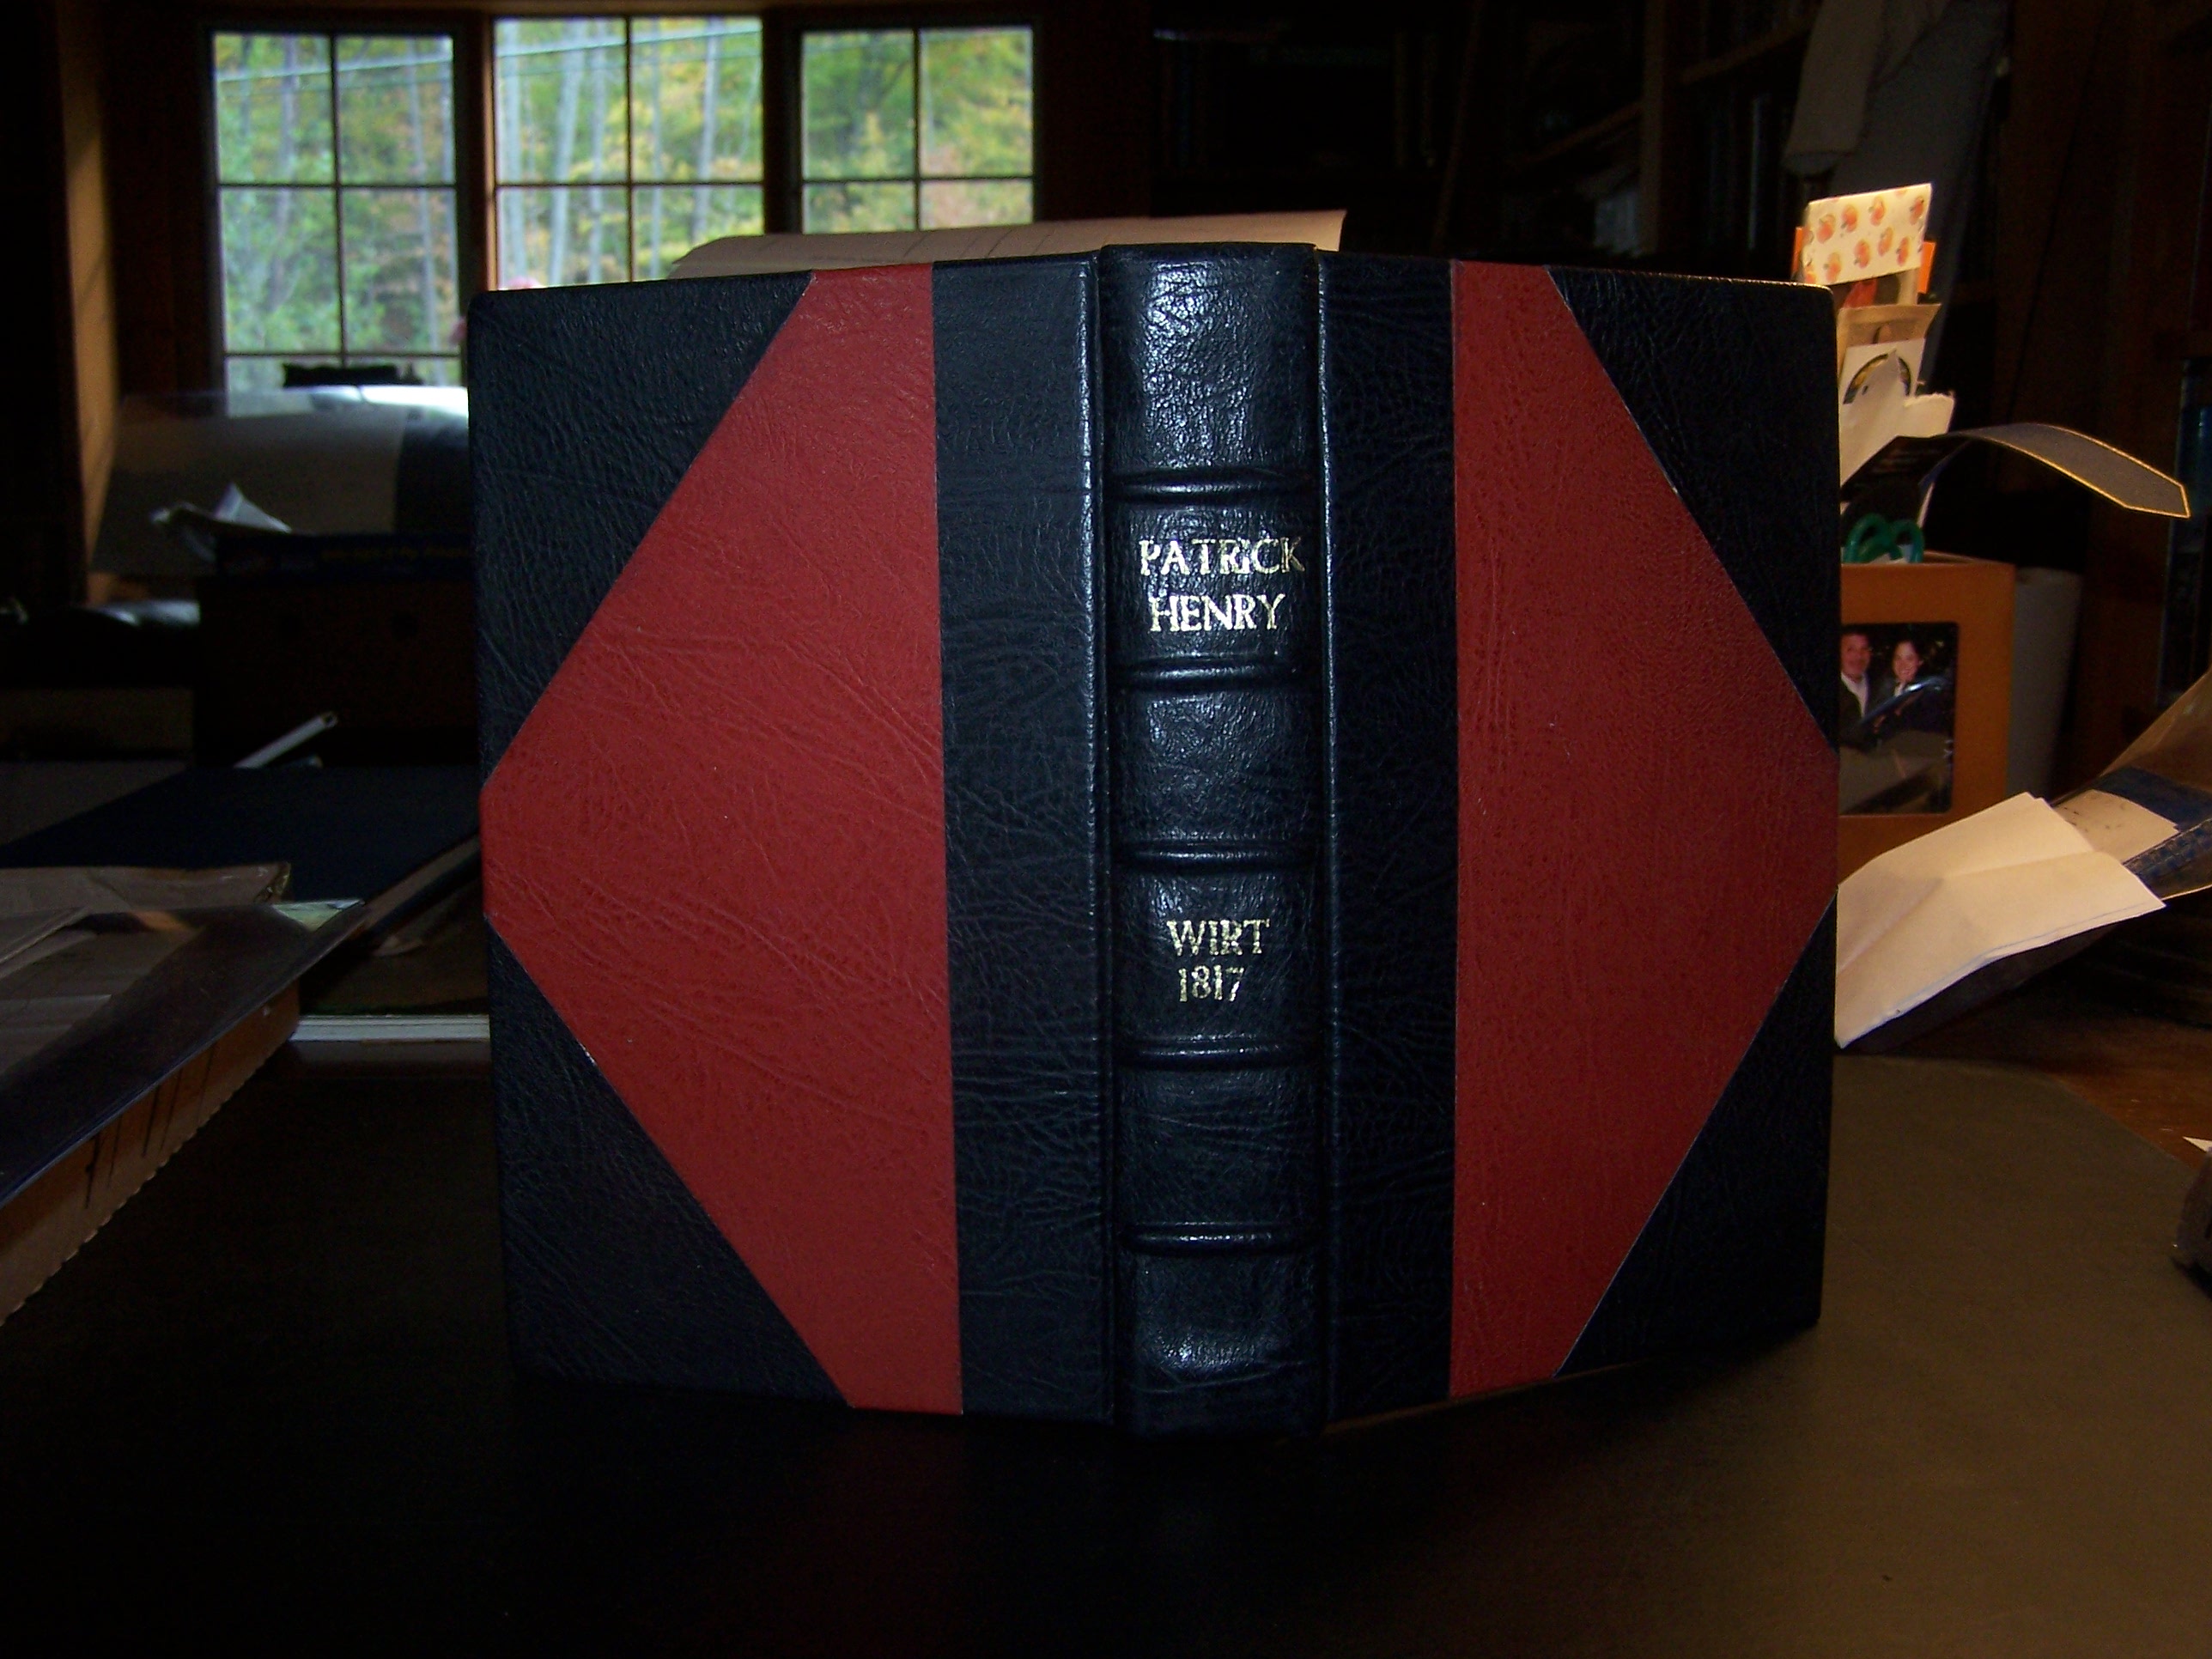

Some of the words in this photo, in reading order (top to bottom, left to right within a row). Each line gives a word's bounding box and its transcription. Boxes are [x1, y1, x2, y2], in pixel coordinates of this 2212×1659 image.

[1139, 537, 1305, 576] PATRICK
[1148, 593, 1286, 632] HENRY
[1166, 918, 1270, 956] WIRT
[1178, 964, 1244, 1002] 1817
